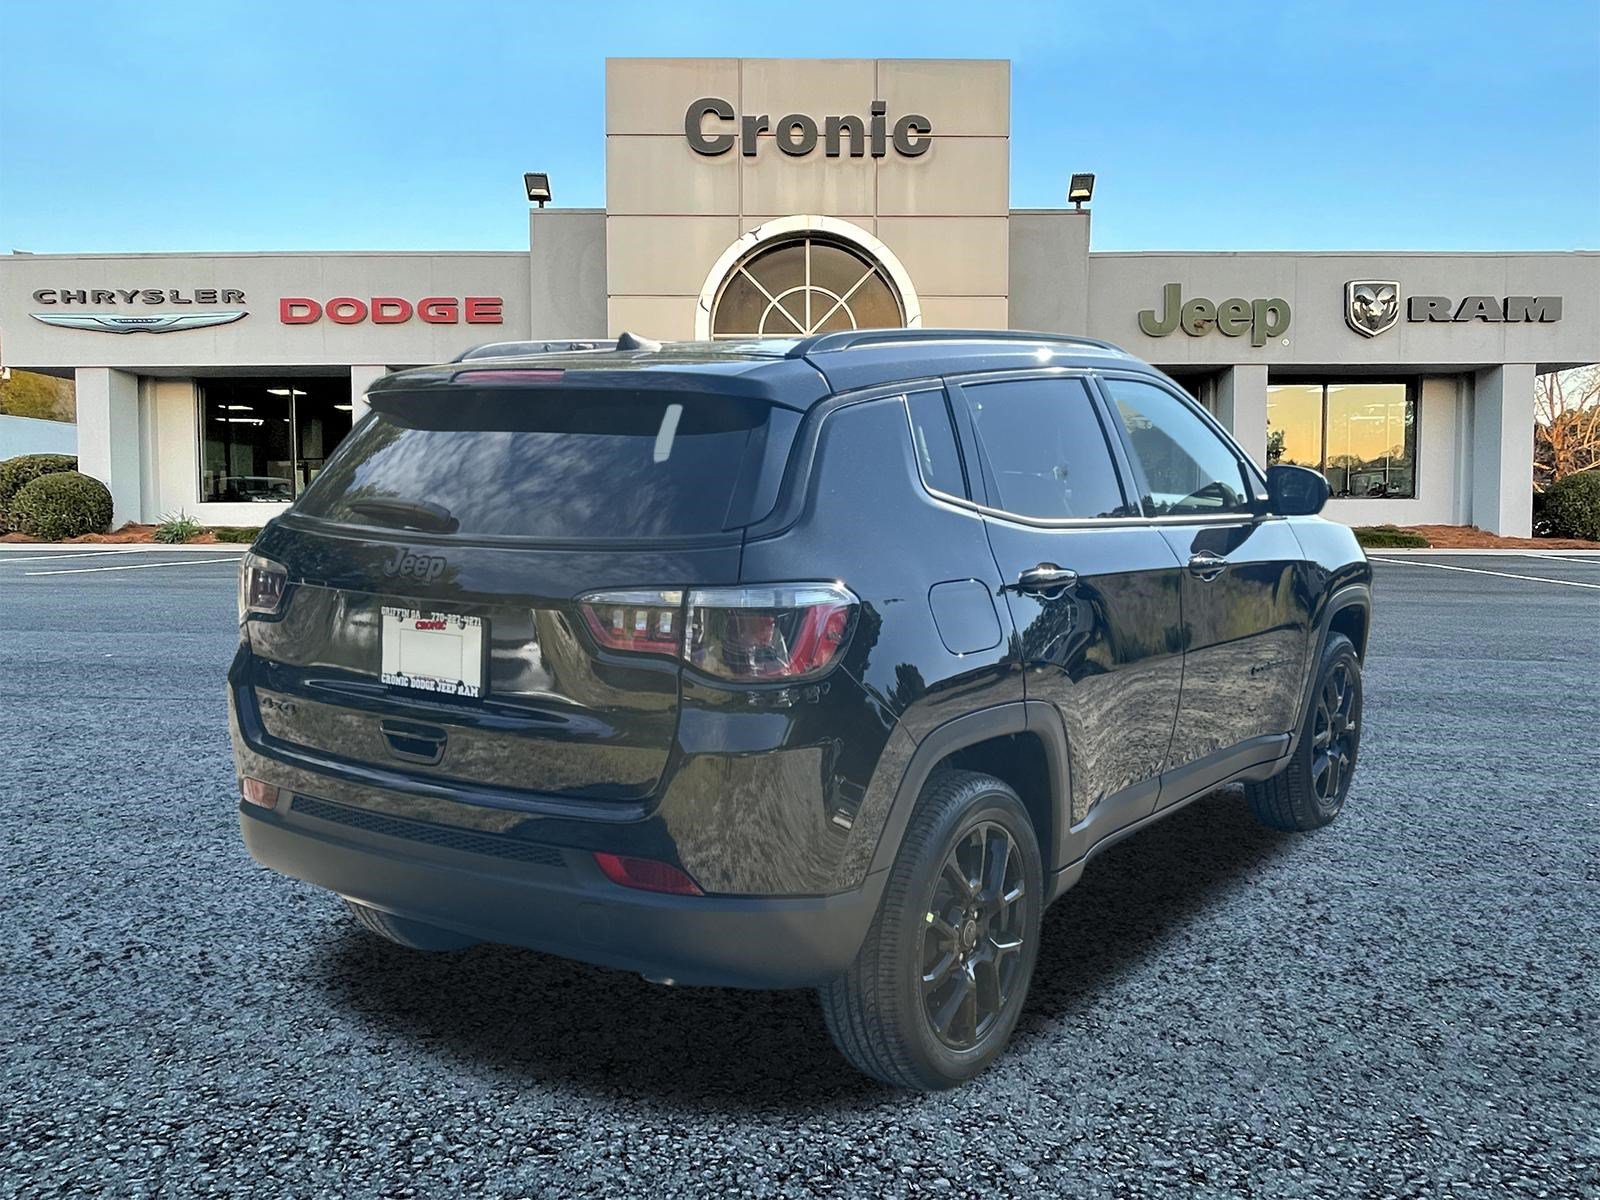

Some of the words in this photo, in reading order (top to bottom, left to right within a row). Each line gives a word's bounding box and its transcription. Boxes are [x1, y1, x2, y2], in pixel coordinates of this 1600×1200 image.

[685, 98, 932, 157] Cronic
[33, 288, 247, 305] CHRYSLER
[280, 296, 503, 325] DODGE
[1407, 296, 1563, 323] RAM
[1138, 283, 1291, 347] Jeep
[384, 547, 447, 584] Jeep
[381, 674, 409, 687] CRONIC
[411, 677, 435, 691] DODGE
[437, 681, 456, 695] JEEP
[458, 685, 479, 698] RAM
[262, 697, 297, 715] 4x4
